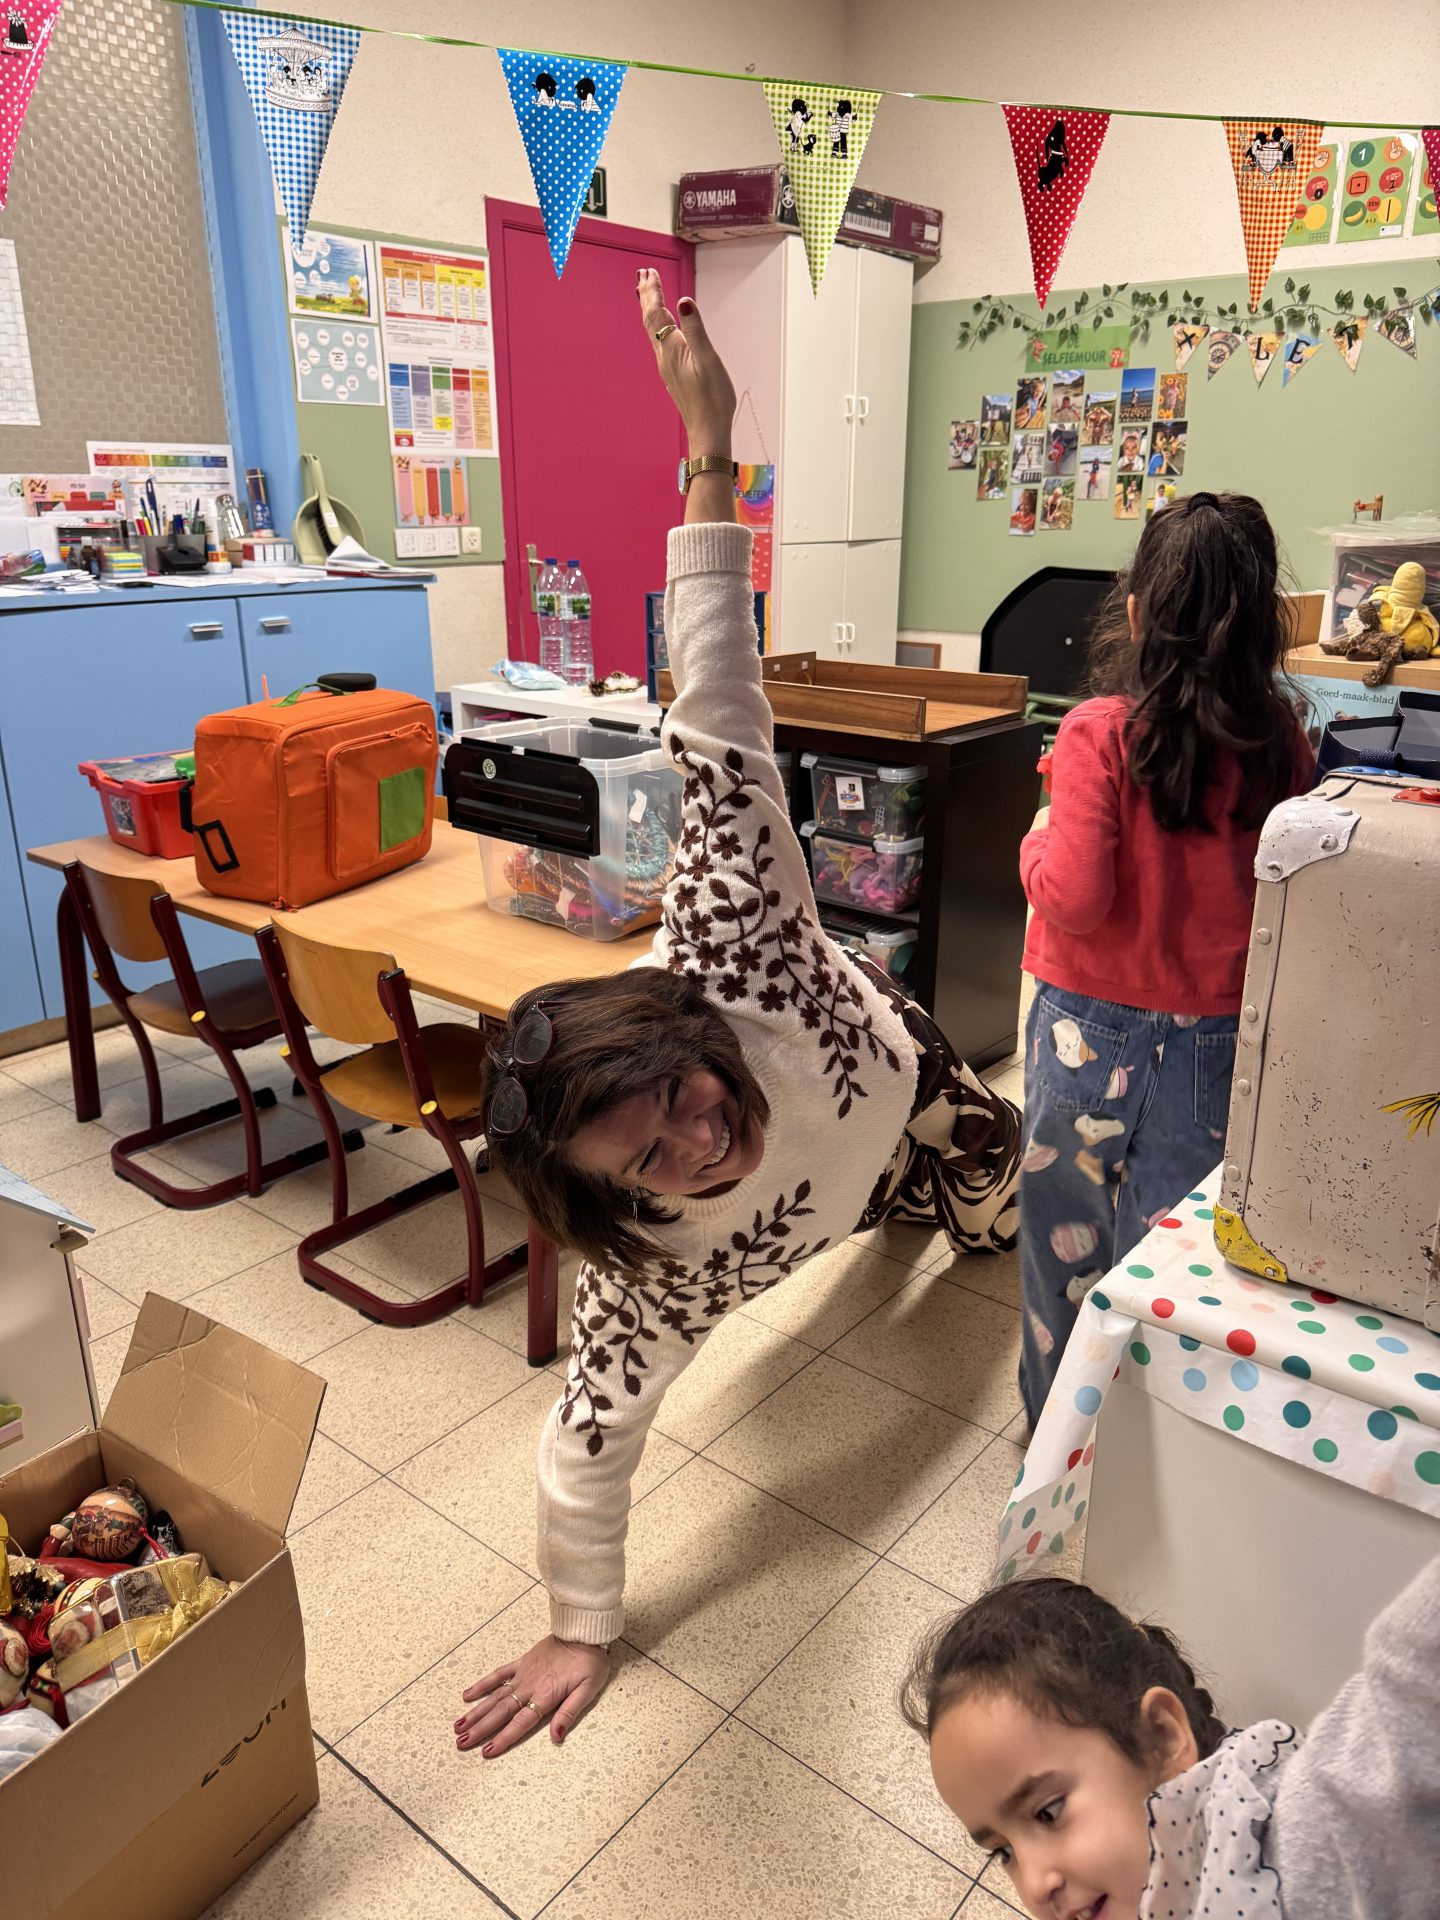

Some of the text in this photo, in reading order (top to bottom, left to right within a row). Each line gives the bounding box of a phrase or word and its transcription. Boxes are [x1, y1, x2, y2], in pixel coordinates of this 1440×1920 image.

[1359, 148, 1366, 160] 1
[696, 189, 737, 208] YAMAHA
[1066, 336, 1081, 349] DE
[1042, 350, 1107, 365] SELFIEMUUR
[1316, 688, 1394, 704] Goed-maak-blad
